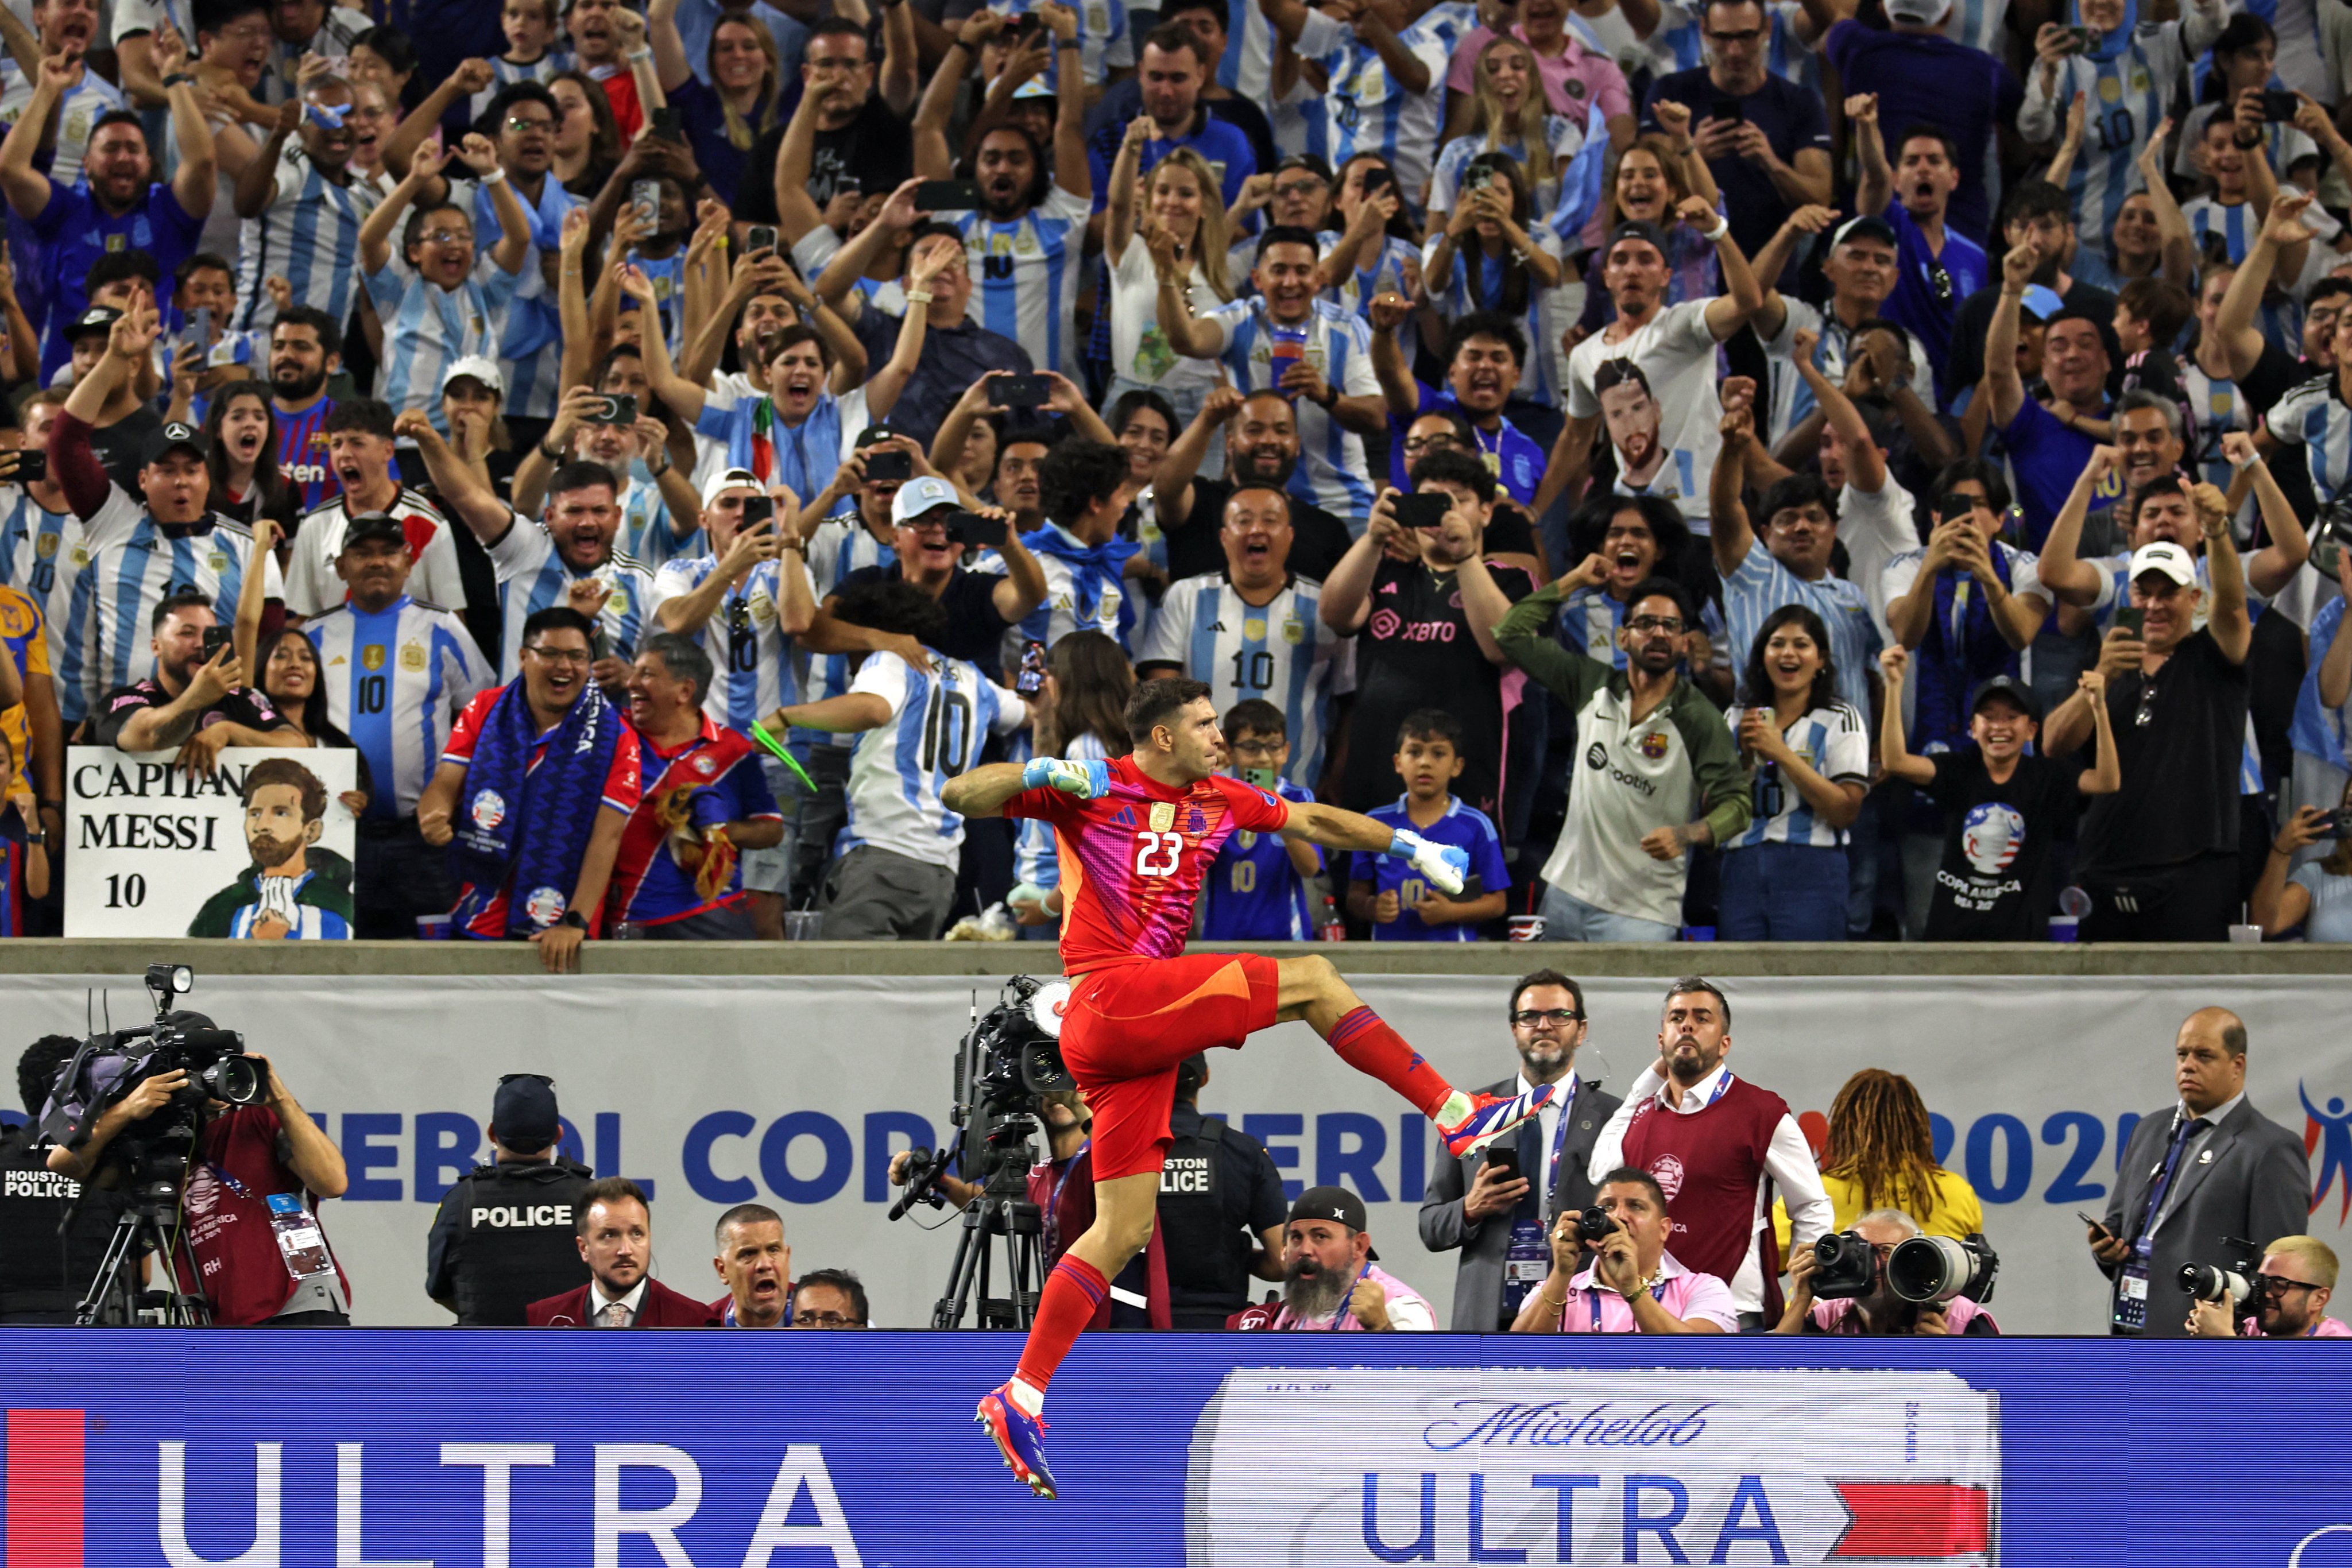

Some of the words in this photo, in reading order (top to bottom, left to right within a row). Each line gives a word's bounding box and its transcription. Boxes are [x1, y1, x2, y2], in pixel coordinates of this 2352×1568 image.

[2094, 109, 2136, 152] 10
[28, 560, 56, 594] 10
[1402, 621, 1456, 642] XBTO
[729, 632, 757, 673] 10
[1230, 651, 1274, 690] 10
[358, 676, 386, 714] 10
[923, 683, 970, 779] 10
[74, 762, 250, 802] CAPITAN
[79, 814, 219, 851] MESSI
[1137, 831, 1183, 876] 23
[105, 874, 146, 908] 10
[1232, 860, 1256, 893] 10
[1401, 878, 1425, 911] 10
[1936, 870, 1970, 894] COPA
[682, 1110, 976, 1204] COP
[5, 1183, 81, 1198] POLICE
[1159, 1171, 1209, 1193] LICE
[471, 1205, 572, 1228] POLICE
[203, 1257, 222, 1276] RH
[1423, 1400, 1716, 1451] Michelob
[158, 1441, 864, 1568] ULTRA
[1360, 1473, 1791, 1565] ULTRA
